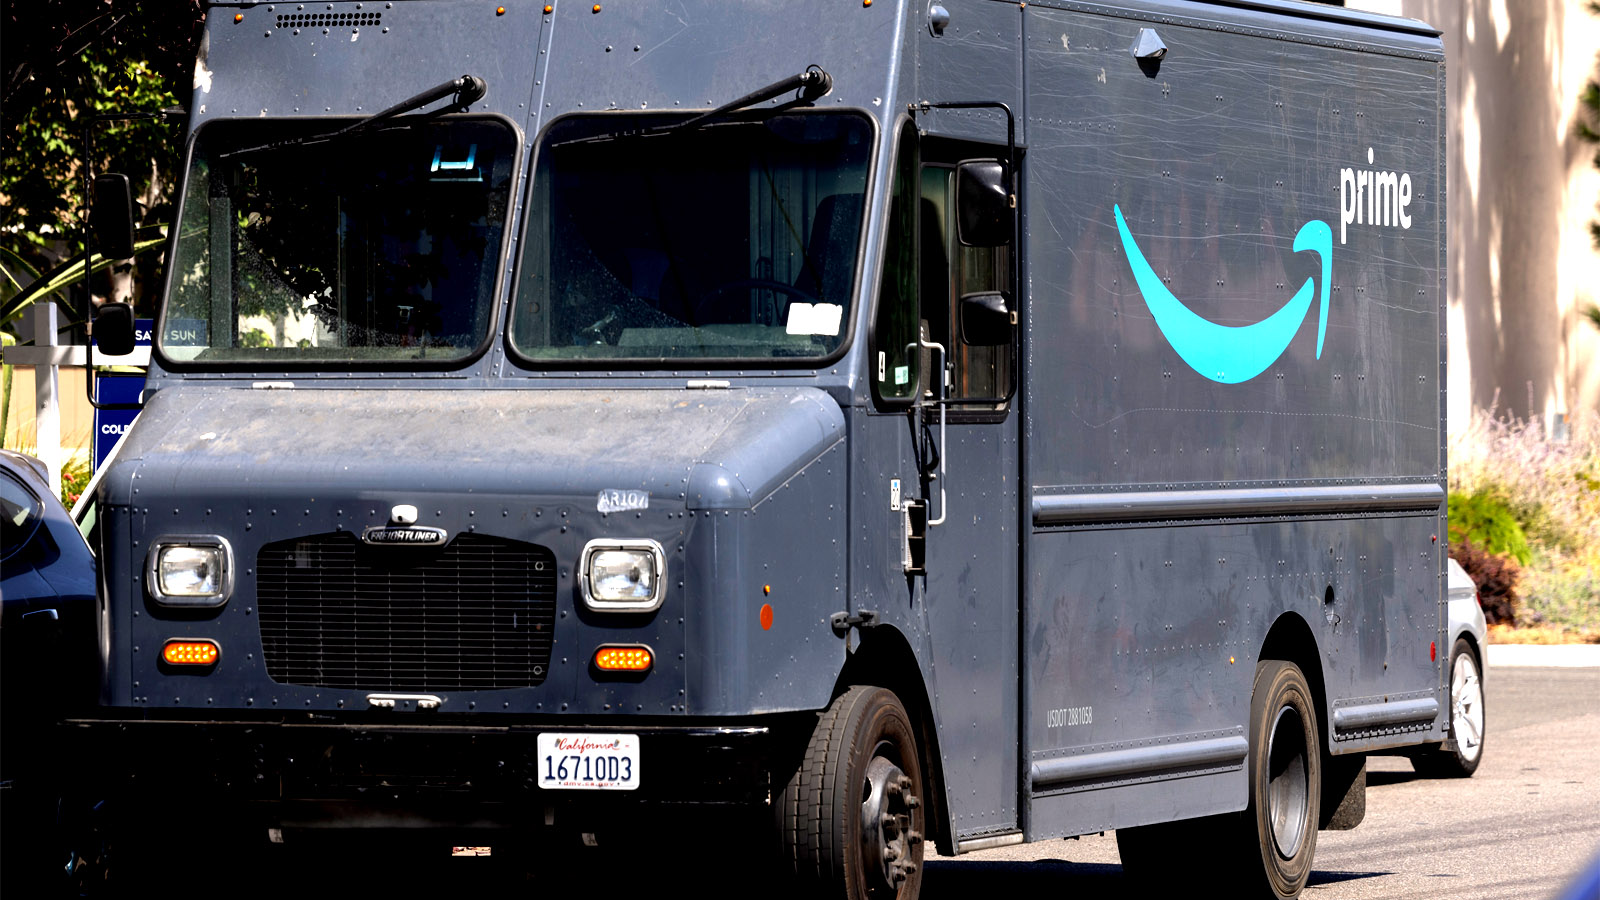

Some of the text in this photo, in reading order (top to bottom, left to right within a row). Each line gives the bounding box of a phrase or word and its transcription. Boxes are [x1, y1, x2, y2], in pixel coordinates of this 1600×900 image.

[1340, 147, 1412, 244] prime
[135, 330, 152, 340] SA
[170, 330, 195, 341] SUN
[1047, 706, 1093, 728] USDOT 2881058
[559, 738, 619, 754] California
[545, 755, 631, 782] 16710D3
